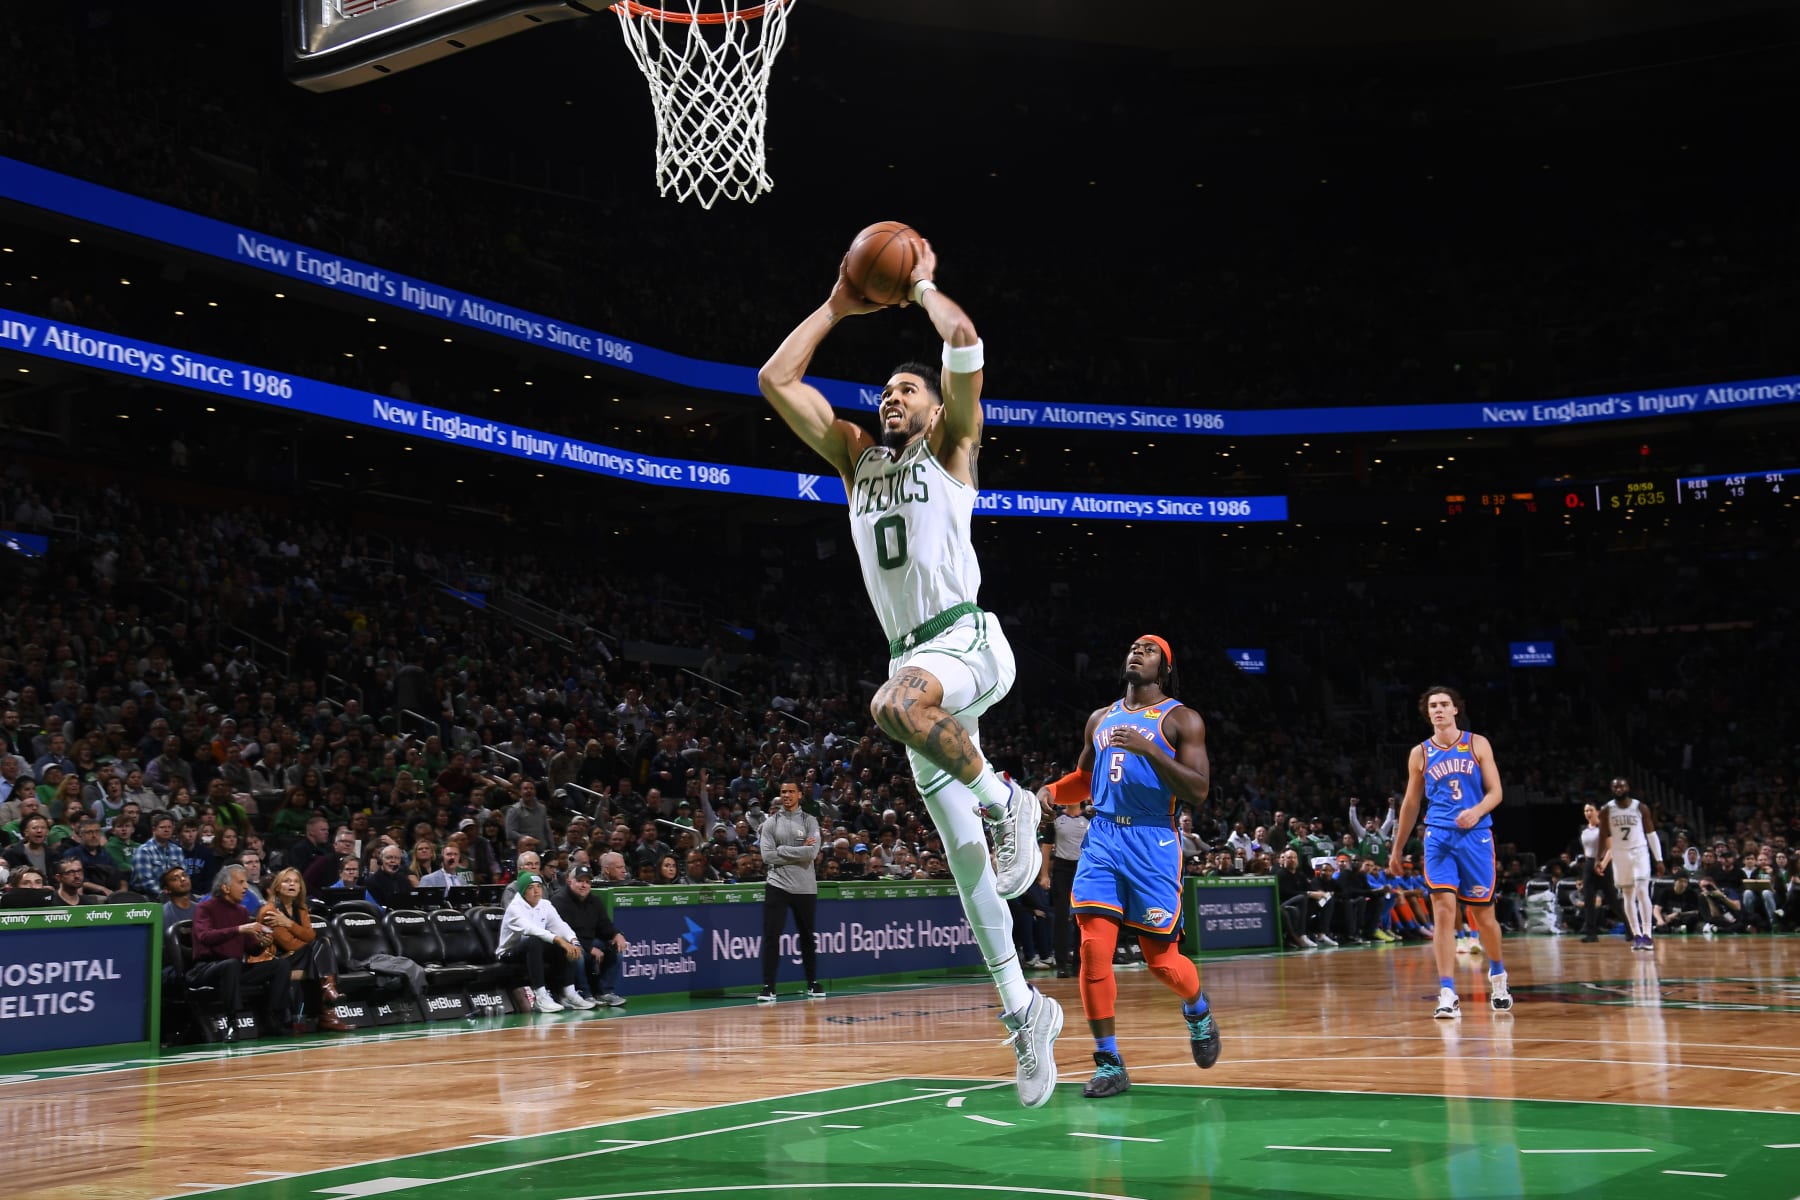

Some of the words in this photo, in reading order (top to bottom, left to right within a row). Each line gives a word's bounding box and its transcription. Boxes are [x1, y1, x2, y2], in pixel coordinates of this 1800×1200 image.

[237, 232, 290, 267] New
[296, 250, 397, 298] England's
[401, 281, 455, 317] Injury
[459, 299, 543, 339] Attorneys
[547, 324, 591, 352] Since
[596, 337, 633, 363] 1986
[0, 319, 37, 348] ury
[42, 325, 165, 373] Attorneys
[171, 353, 234, 387] Since
[241, 369, 293, 399] 1986
[859, 388, 883, 407] Ne
[1482, 406, 1527, 422] New
[1532, 398, 1632, 422] England's
[1638, 391, 1698, 411] Injury
[986, 404, 1038, 425] Injury
[1041, 406, 1126, 428] Attorneys
[1130, 410, 1178, 428] Since
[1183, 412, 1224, 430] 1986
[373, 398, 418, 427] New
[422, 410, 507, 447] England's
[511, 429, 558, 461] Injury
[561, 441, 634, 475] Attorneys
[637, 458, 682, 481] Since
[688, 465, 730, 486] 1986
[856, 463, 929, 517] CELTICS
[1688, 479, 1708, 489] REB
[1725, 476, 1746, 486] AST
[1766, 473, 1784, 483] STL
[1017, 494, 1067, 514] Injury
[1071, 496, 1153, 516] Attorneys
[1157, 499, 1203, 515] Since
[1208, 500, 1250, 517] 1986
[1694, 490, 1708, 500] 31
[1730, 487, 1744, 497] 15
[874, 514, 908, 570] 0
[1110, 752, 1126, 784] 5
[1428, 758, 1475, 781] THUNDER
[1449, 779, 1463, 800] 3
[1620, 827, 1631, 840] 7
[44, 912, 73, 924] xfinity
[86, 910, 113, 922] xfinity
[126, 908, 152, 919] xfinity
[651, 938, 682, 955] Israel
[712, 928, 762, 961] New
[779, 922, 846, 965] ngand
[851, 920, 915, 959] Baptist
[917, 918, 977, 953] Hospit
[0, 958, 121, 987] OSPITAL
[622, 960, 657, 980] Lahey
[659, 956, 697, 975] Health
[0, 990, 95, 1019] ELTICS
[427, 997, 461, 1012] jetBlue
[470, 994, 502, 1007] jetBlue
